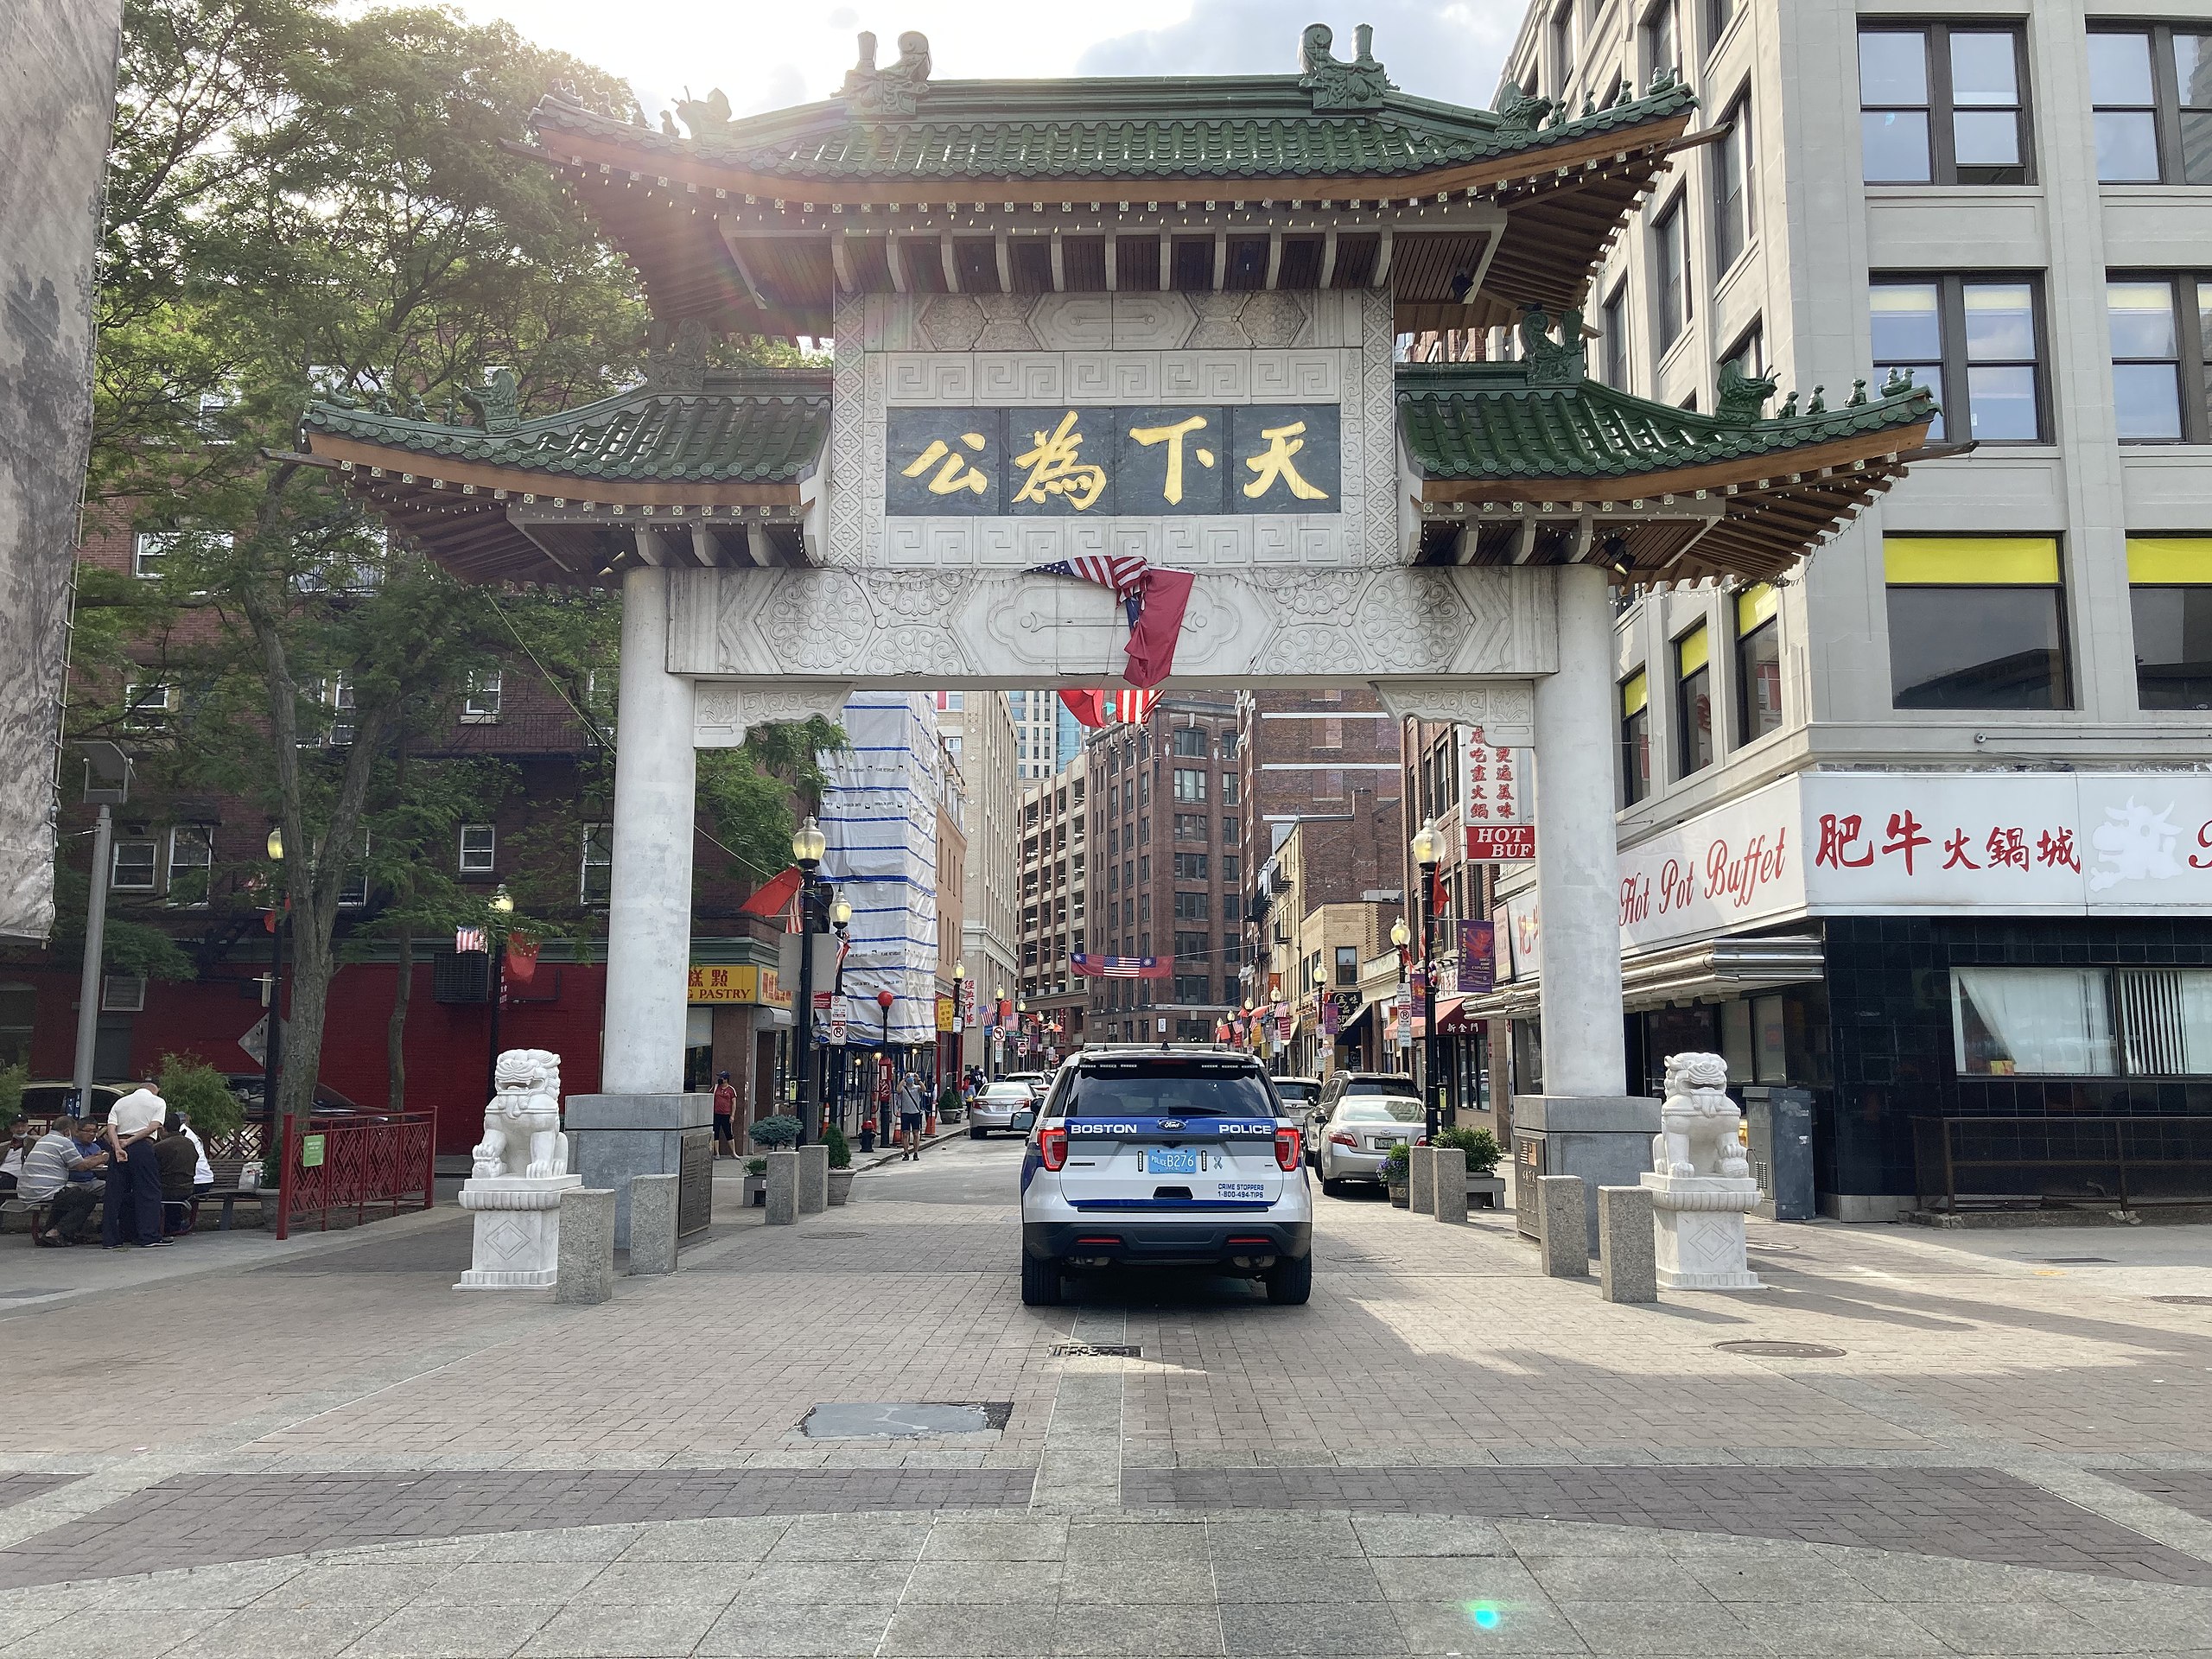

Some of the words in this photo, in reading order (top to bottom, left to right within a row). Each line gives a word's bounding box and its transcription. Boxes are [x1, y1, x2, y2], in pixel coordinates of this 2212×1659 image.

[1477, 828, 1526, 843] HOT
[1815, 809, 2081, 876] 肥牛火鍋城
[1491, 843, 1535, 857] BUF
[1619, 872, 1650, 927] Hot
[1659, 858, 1694, 915] Pot
[1704, 826, 1786, 908] Buffet
[699, 988, 751, 999] PASTRY
[1446, 1022, 1478, 1033] 新金門
[1071, 1124, 1137, 1134] BOSTON
[1218, 1124, 1272, 1135] POLICE
[1151, 1155, 1167, 1166] POLICE
[1166, 1154, 1194, 1167] B276
